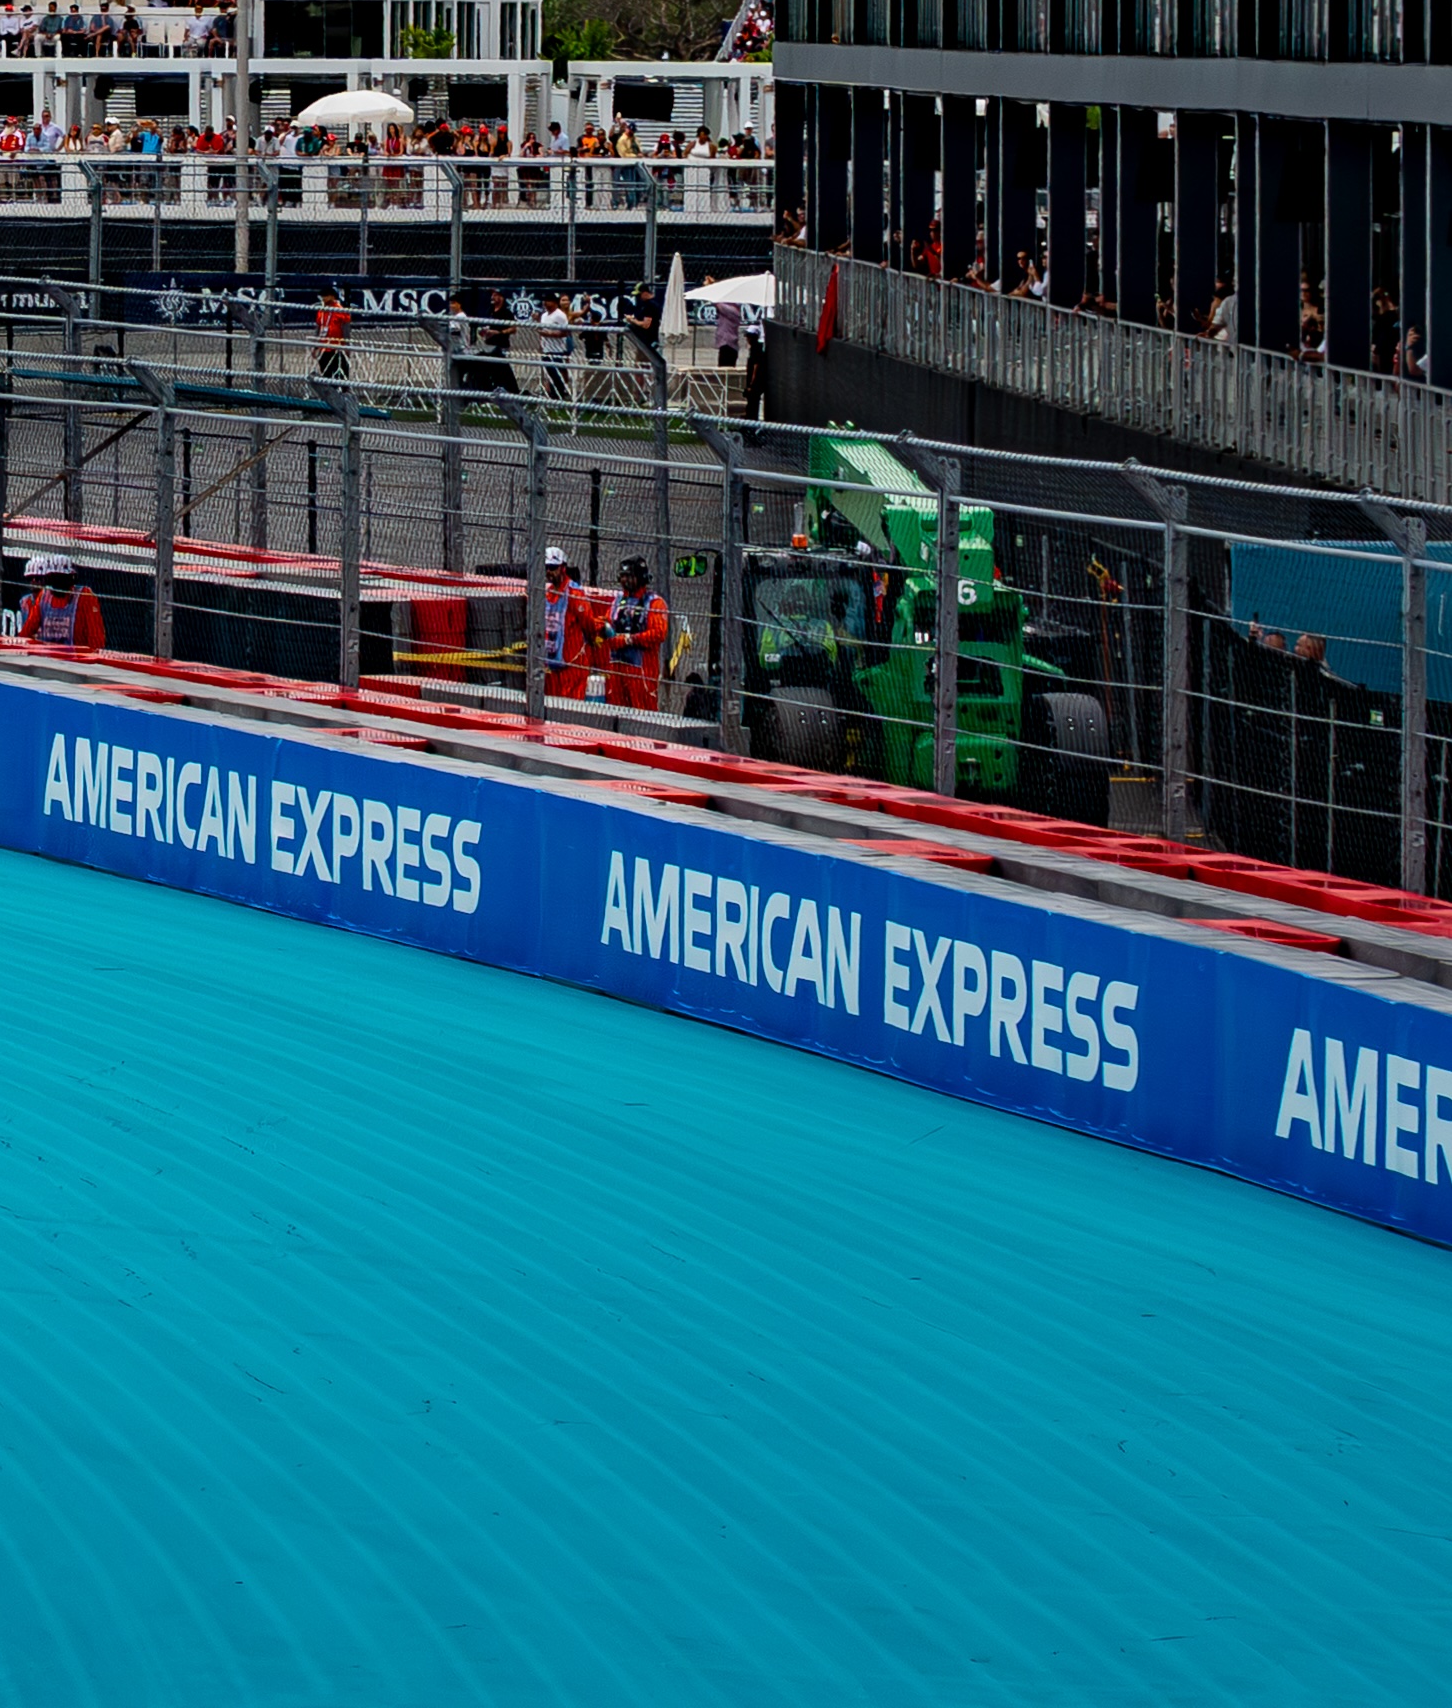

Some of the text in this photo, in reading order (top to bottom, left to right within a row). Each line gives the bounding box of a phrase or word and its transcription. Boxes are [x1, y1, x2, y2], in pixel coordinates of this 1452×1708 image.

[361, 290, 447, 316] MSC
[957, 579, 978, 605] 6
[44, 733, 482, 914] AMERICAN EXPRESS
[601, 850, 1140, 1093] AMERICAN EXPRESS
[1275, 1028, 1452, 1187] AMER
